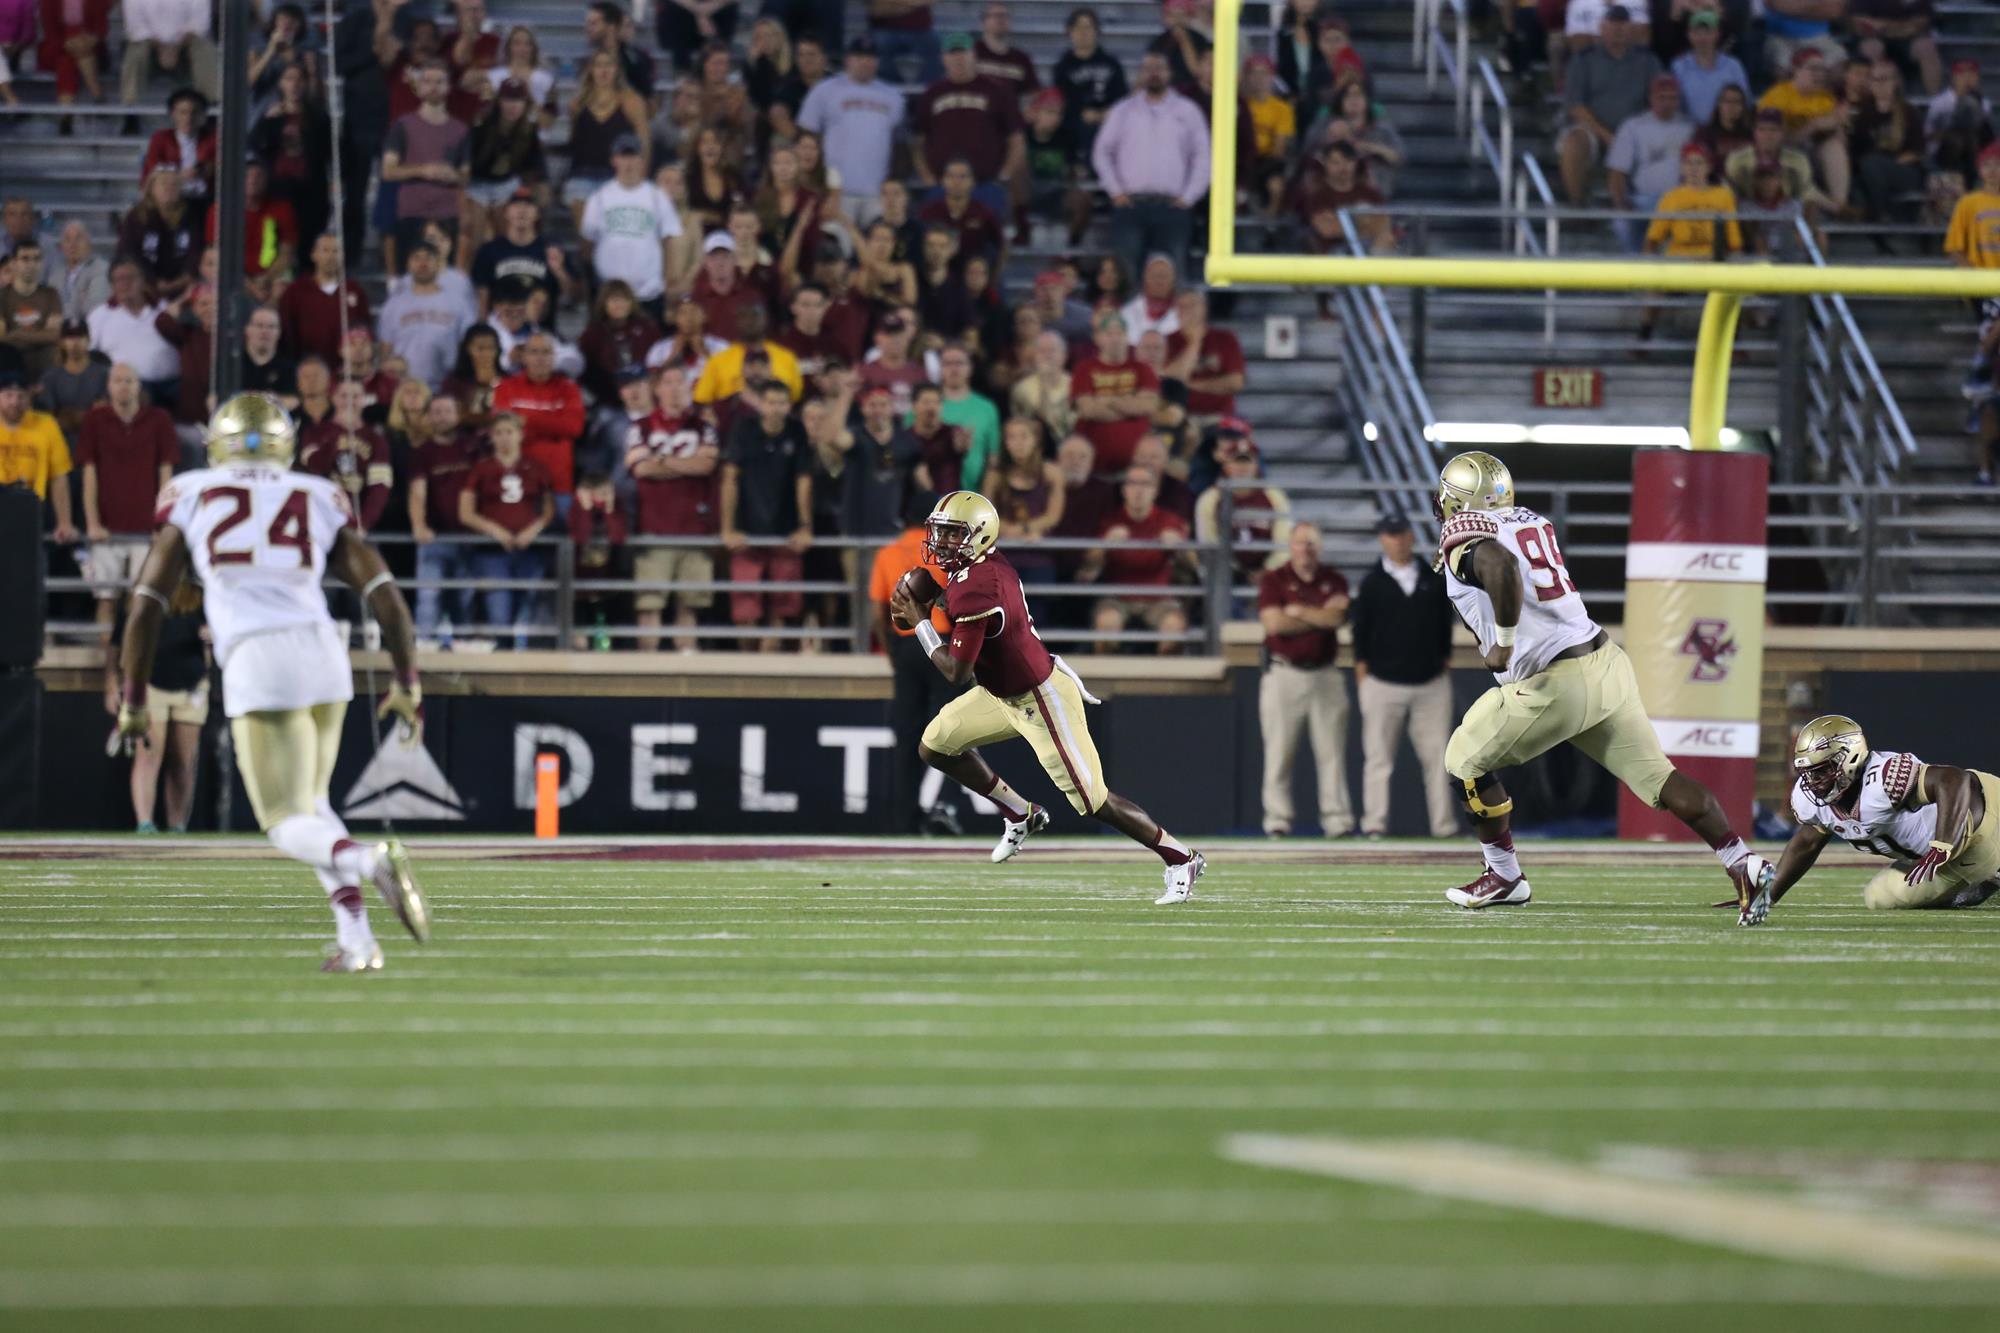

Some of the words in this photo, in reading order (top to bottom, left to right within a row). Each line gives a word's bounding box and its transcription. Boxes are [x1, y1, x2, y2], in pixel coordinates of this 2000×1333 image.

[1544, 371, 1593, 406] EXIT
[501, 474, 523, 503] 3
[202, 486, 313, 567] 24
[1686, 552, 1744, 571] ACC
[1678, 727, 1736, 746] ACC
